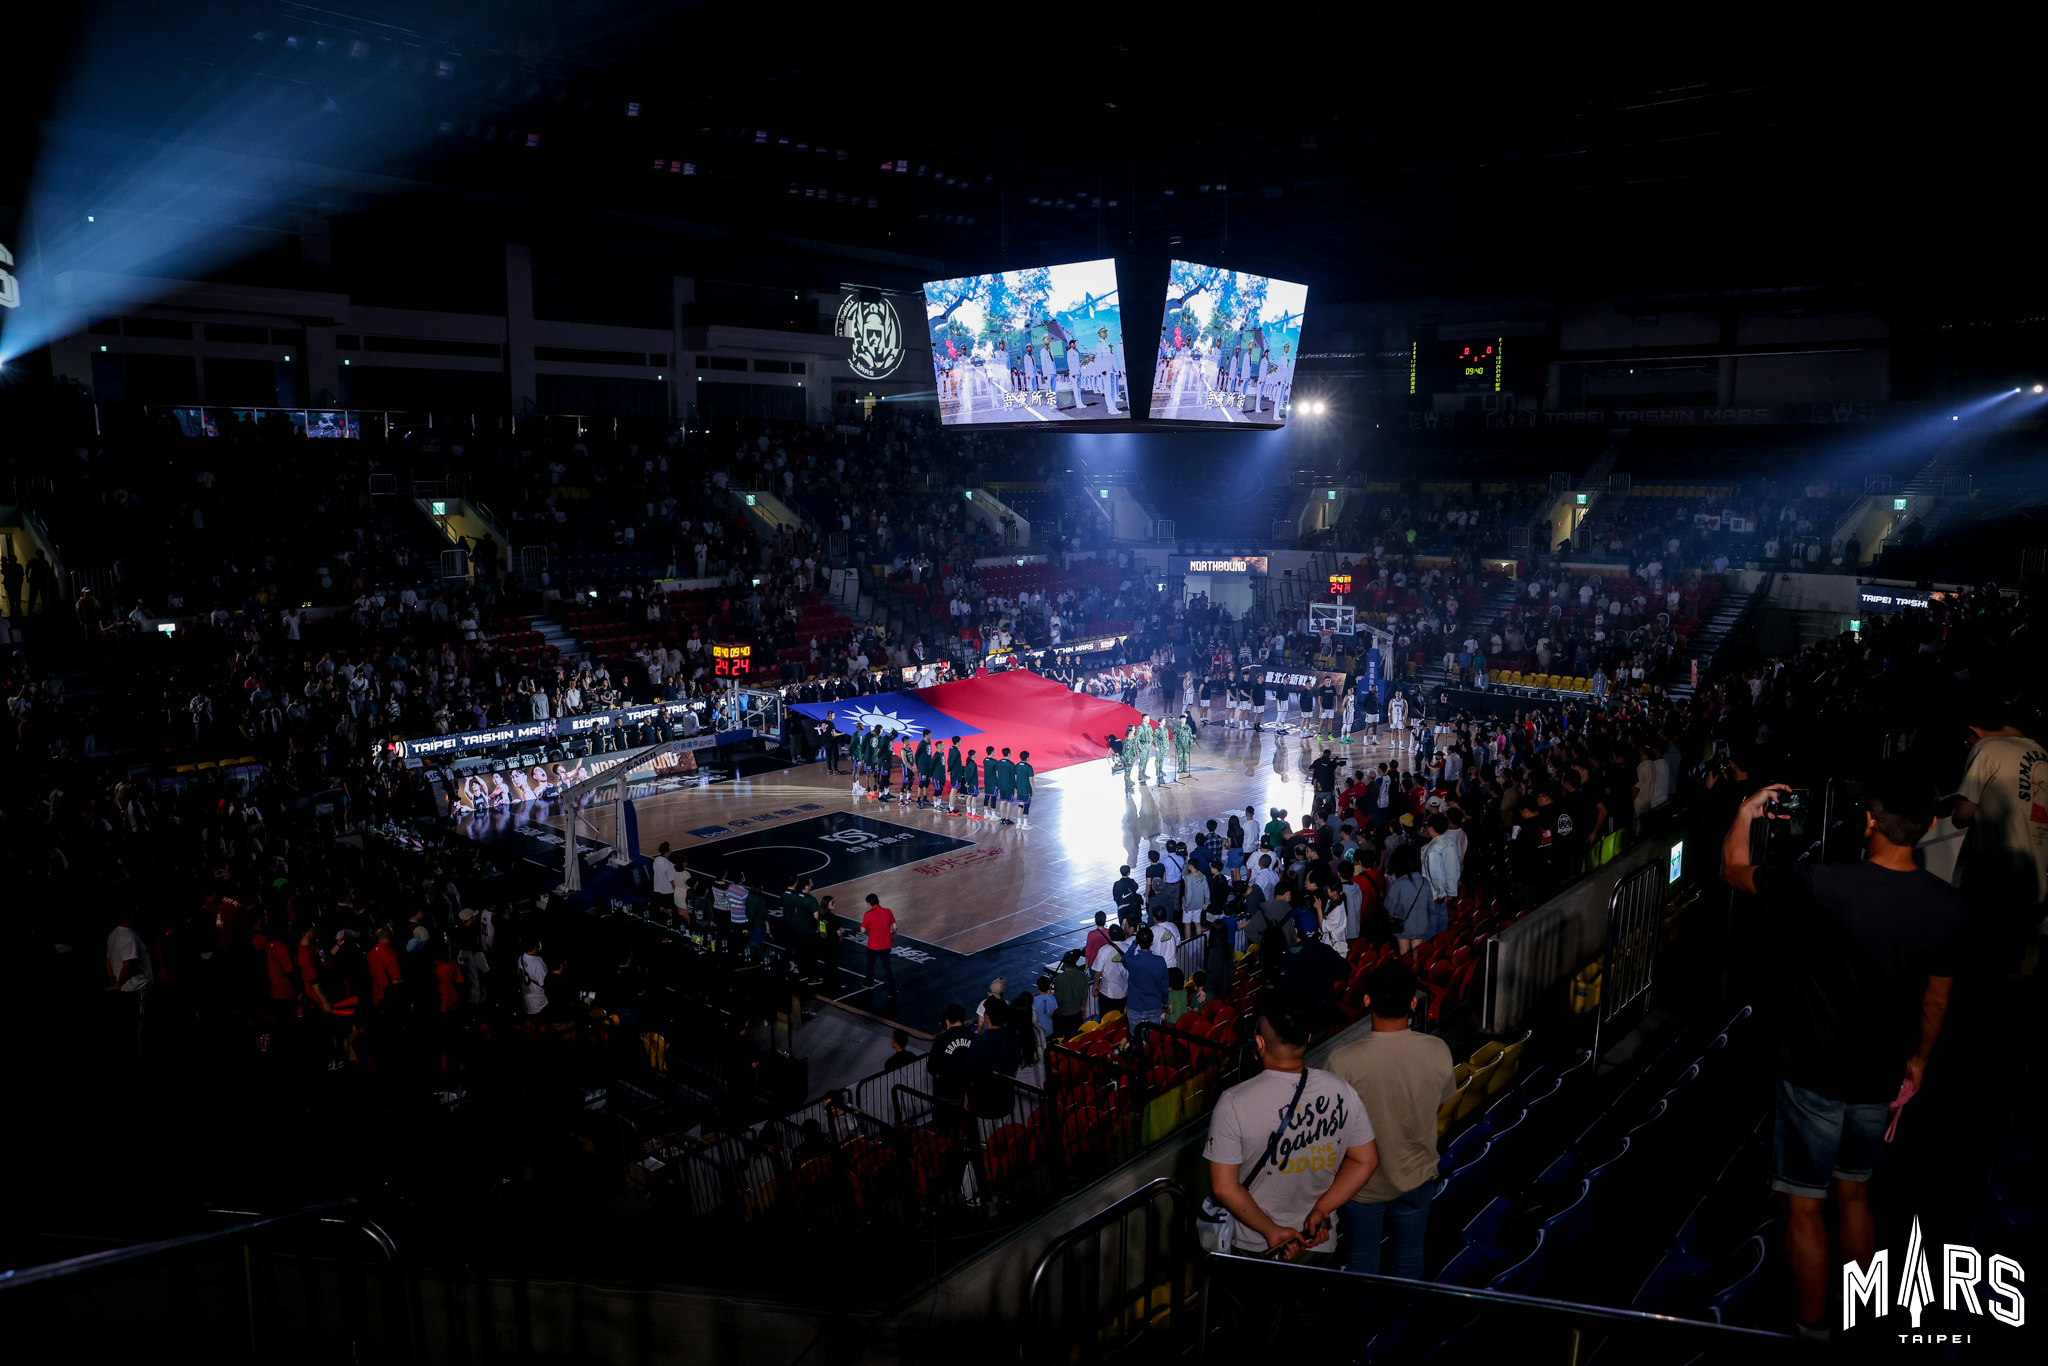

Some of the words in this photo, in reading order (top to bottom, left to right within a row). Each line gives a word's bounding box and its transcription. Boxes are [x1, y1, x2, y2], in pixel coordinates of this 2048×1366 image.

[855, 361, 875, 377] MARS
[1465, 367, 1483, 375] 09:40
[1545, 412, 1604, 423] TAIPEI
[1614, 410, 1694, 422] TAISHIN
[1703, 408, 1769, 420] MARS
[1190, 560, 1247, 572] NORTHBOUND
[1330, 583, 1343, 594] 24
[1861, 594, 1892, 604] TAIPEI
[1895, 598, 1928, 608] TAISHI
[715, 658, 729, 675] 24
[732, 659, 749, 676] 24
[1265, 671, 1317, 687] 臺北新戰神
[627, 709, 662, 720] TAIPE
[412, 738, 456, 753] TAIPEI
[462, 730, 513, 745] TAISHIN
[627, 752, 656, 770] GARED
[912, 846, 1004, 876] 新光三越
[1278, 1095, 1330, 1130] Rise
[1266, 1093, 1348, 1171] Against
[1308, 1142, 1333, 1155] THE
[1278, 1152, 1337, 1175] ODDS
